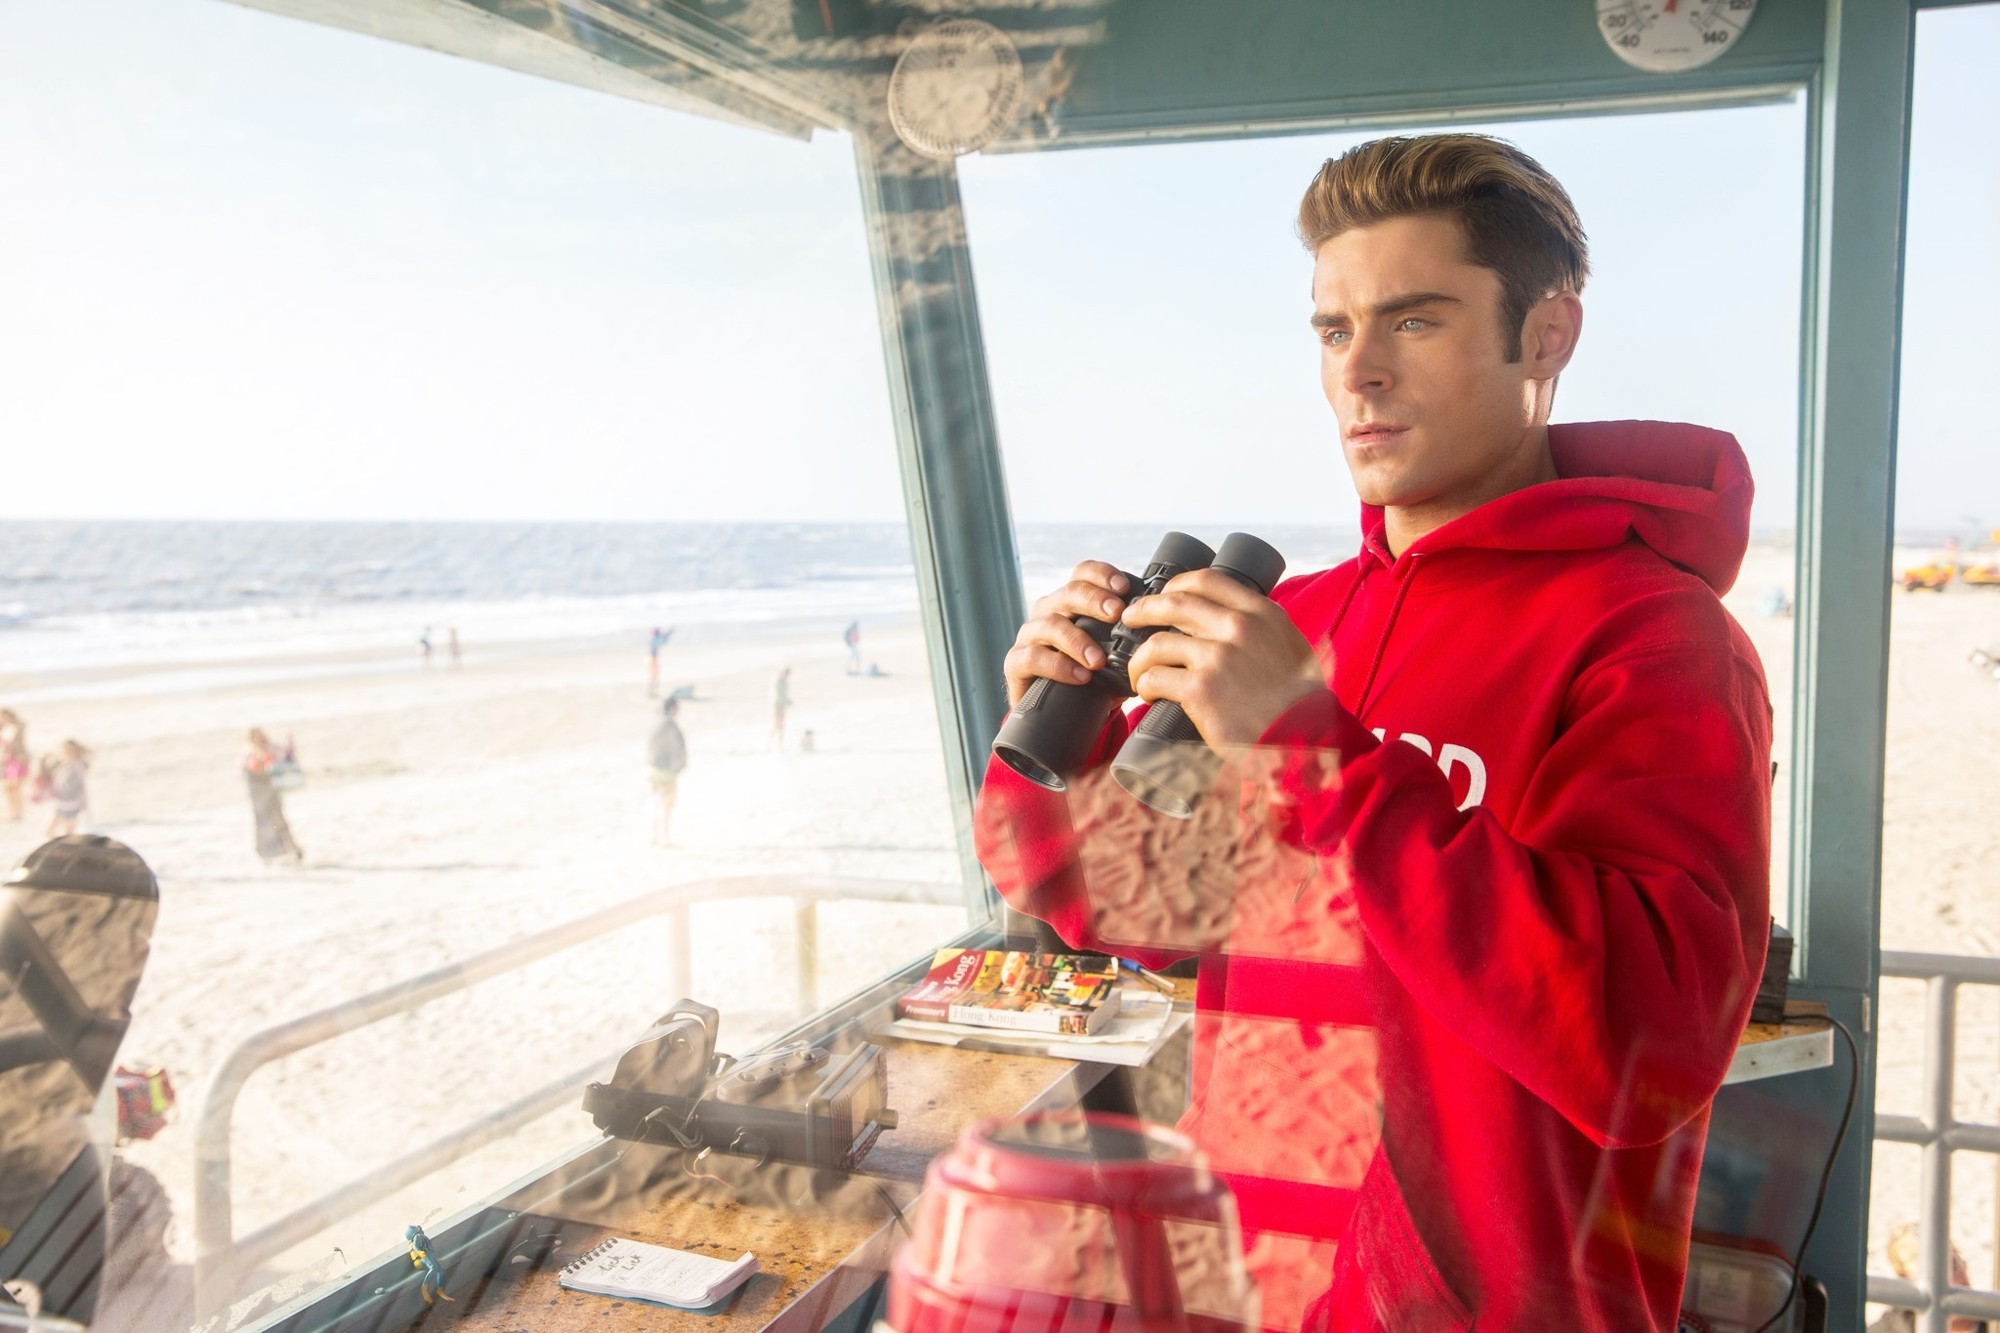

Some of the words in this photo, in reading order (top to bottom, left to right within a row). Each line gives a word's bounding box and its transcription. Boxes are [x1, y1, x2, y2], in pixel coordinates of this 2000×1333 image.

[1702, 30, 1728, 44] 140
[953, 1007, 983, 1022] Hong
[987, 1009, 1017, 1025] Kong
